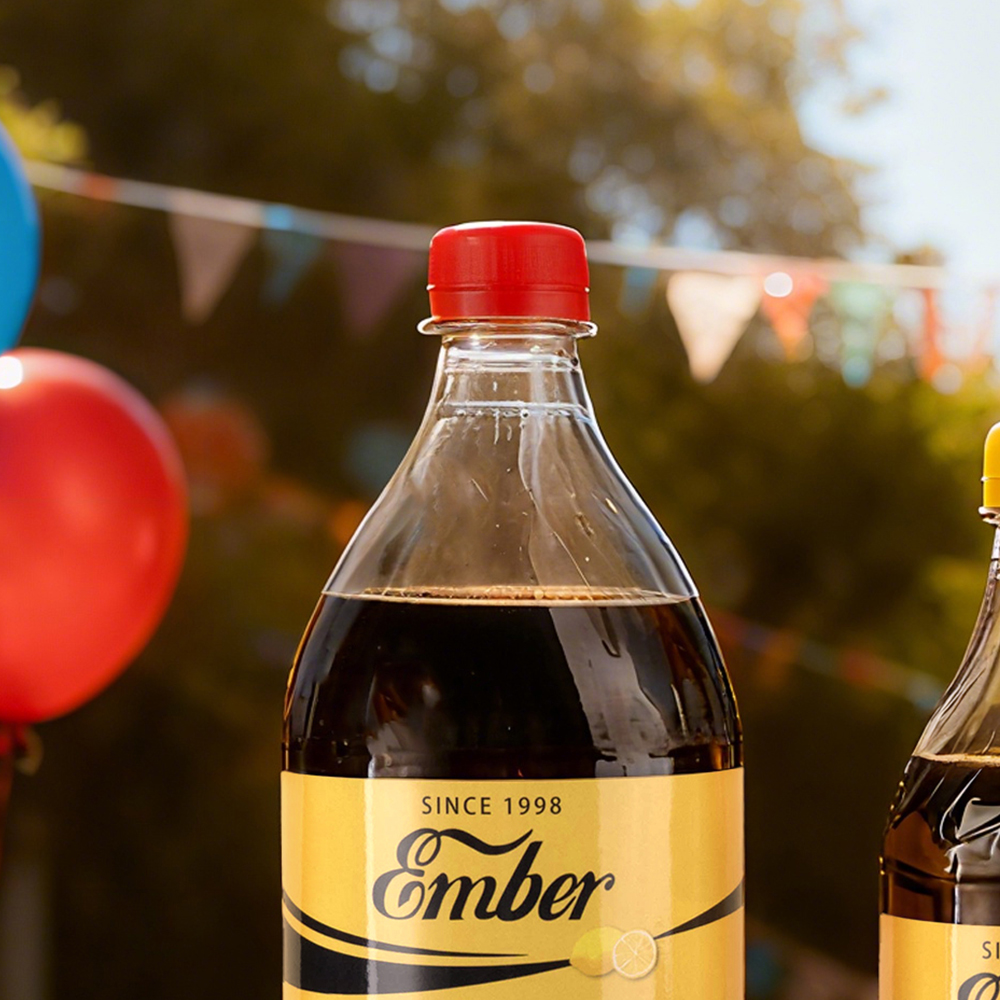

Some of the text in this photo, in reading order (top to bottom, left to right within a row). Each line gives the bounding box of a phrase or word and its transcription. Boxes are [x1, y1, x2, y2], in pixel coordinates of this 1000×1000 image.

[422, 795, 562, 816] SINCE 1998
[371, 827, 616, 922] Ember
